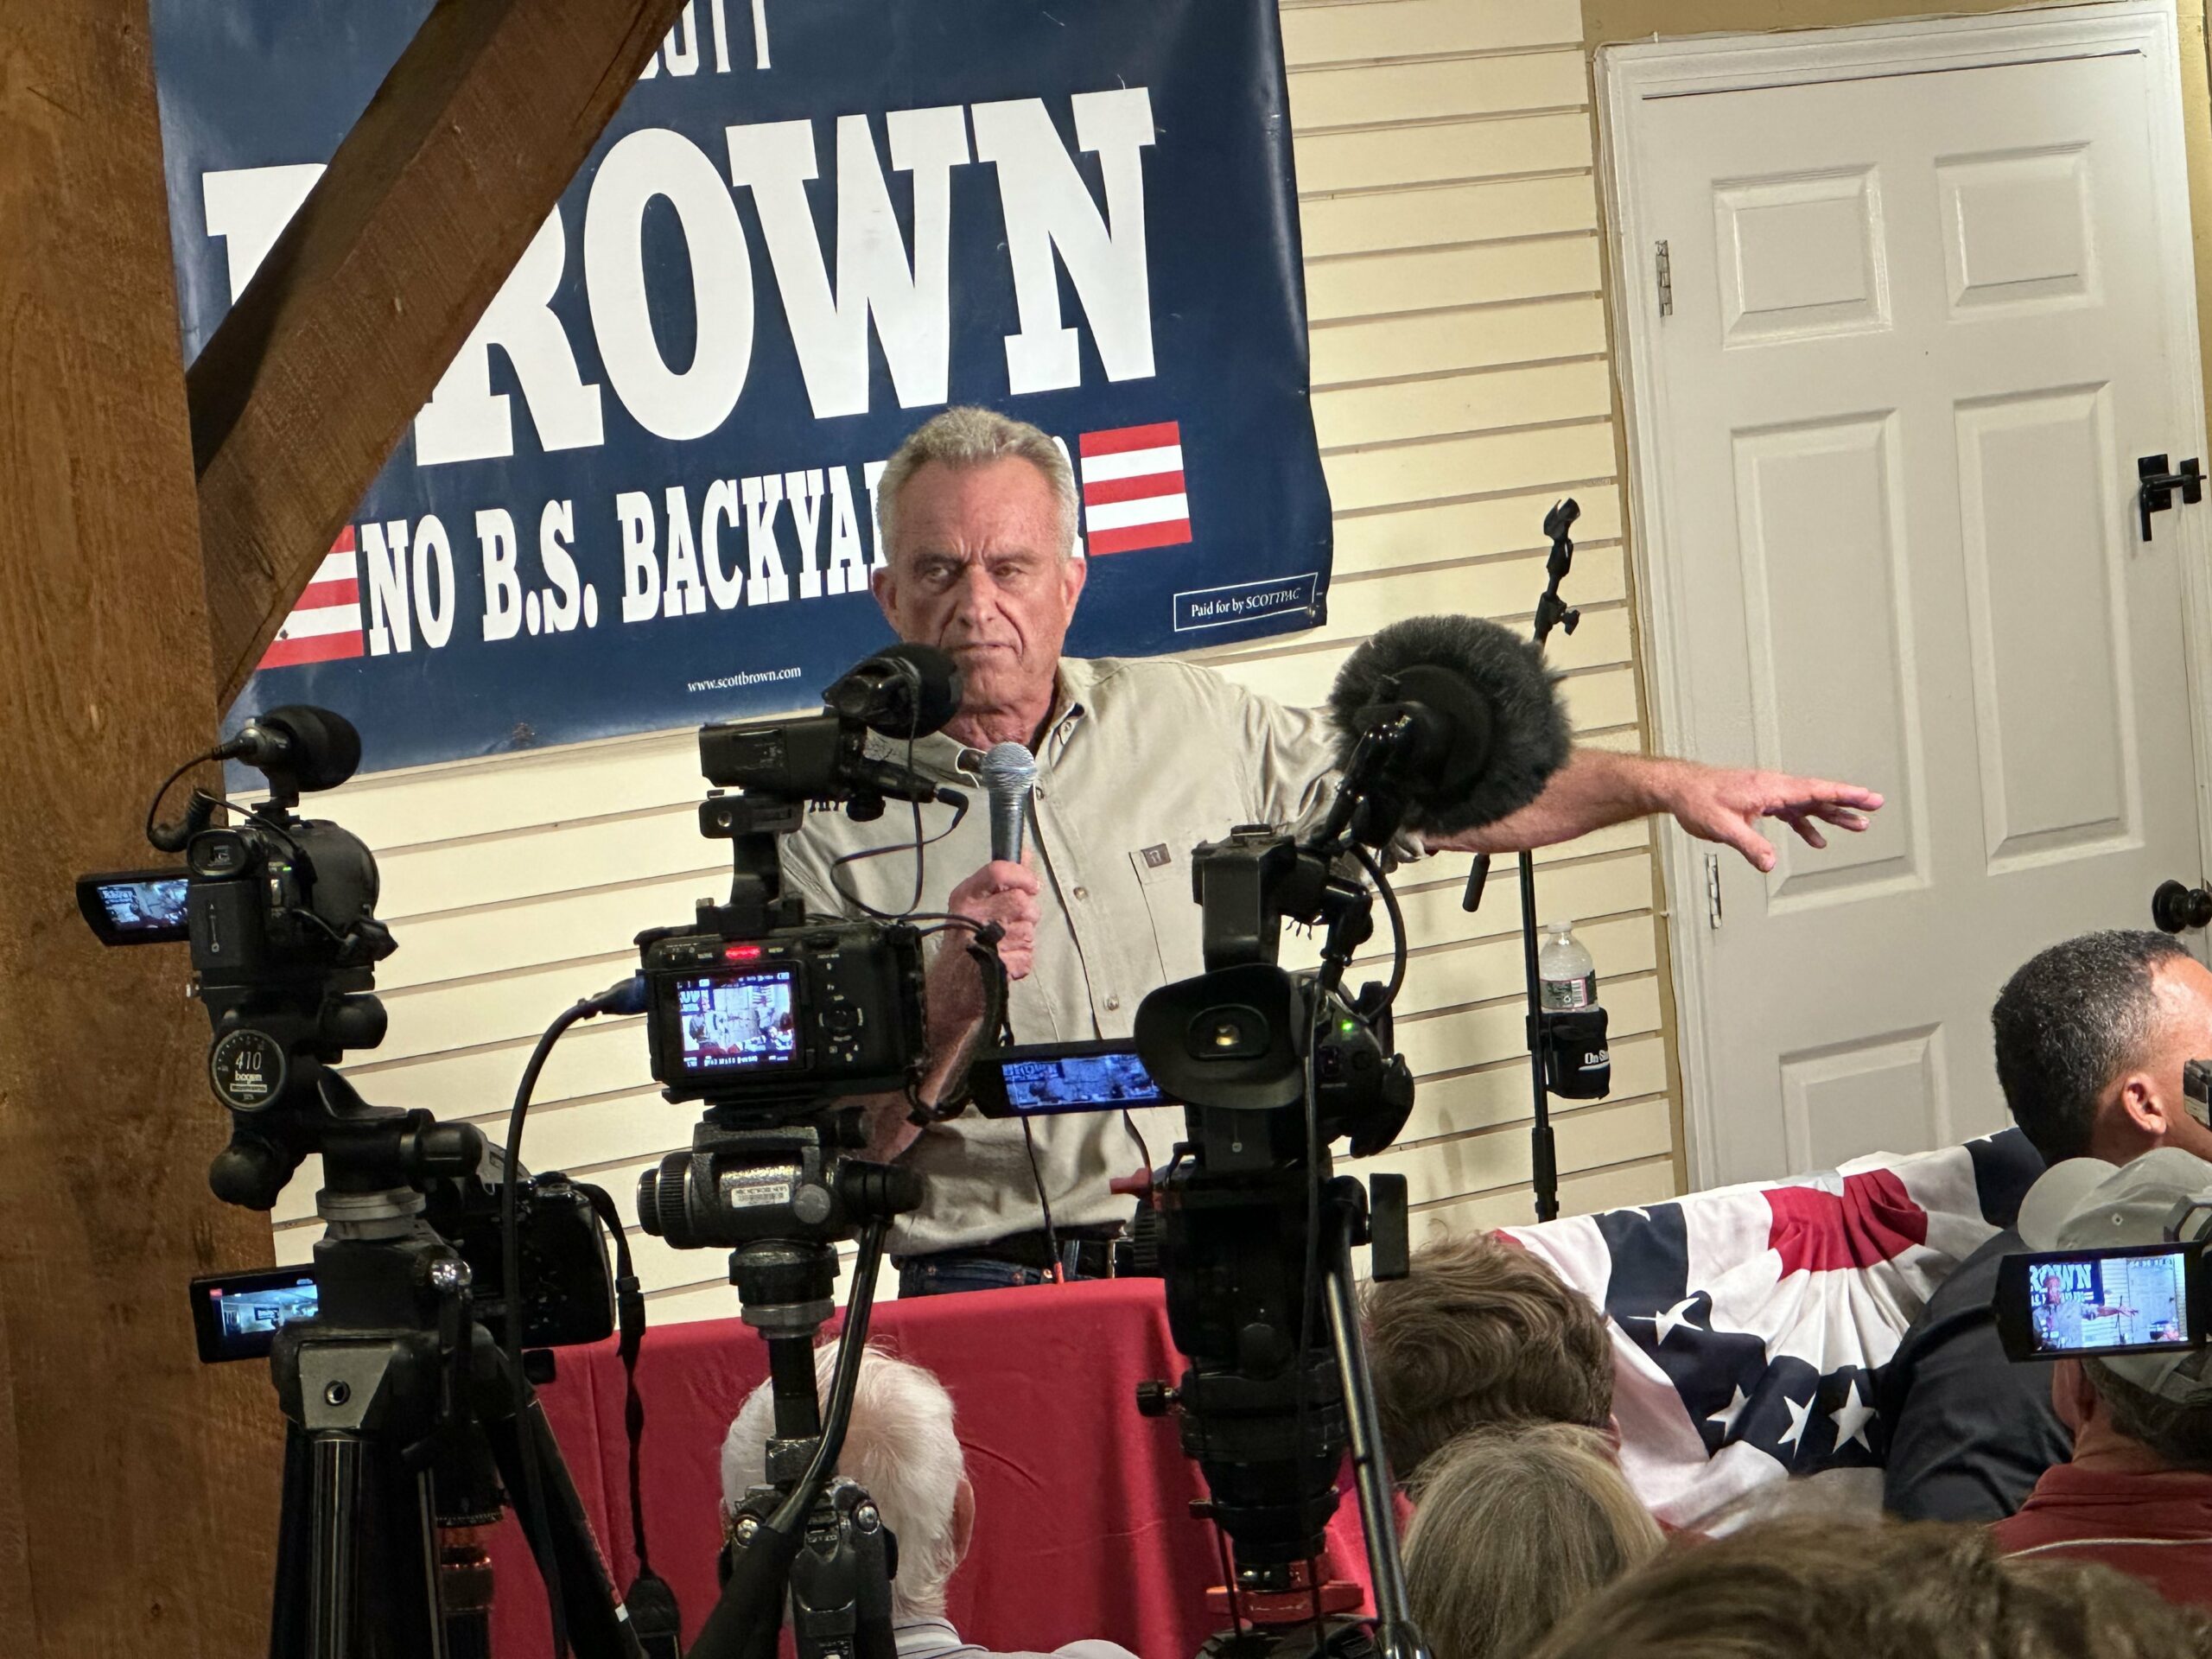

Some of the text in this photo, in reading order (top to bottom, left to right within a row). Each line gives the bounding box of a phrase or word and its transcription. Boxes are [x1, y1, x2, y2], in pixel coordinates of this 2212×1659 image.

[361, 514, 455, 657] NO
[475, 499, 598, 642] B.S.
[1192, 601, 1213, 618] Paid
[1216, 599, 1230, 614] for
[1232, 598, 1245, 614] by
[687, 666, 802, 692] www.scottbrown.com
[235, 1051, 263, 1071] 410
